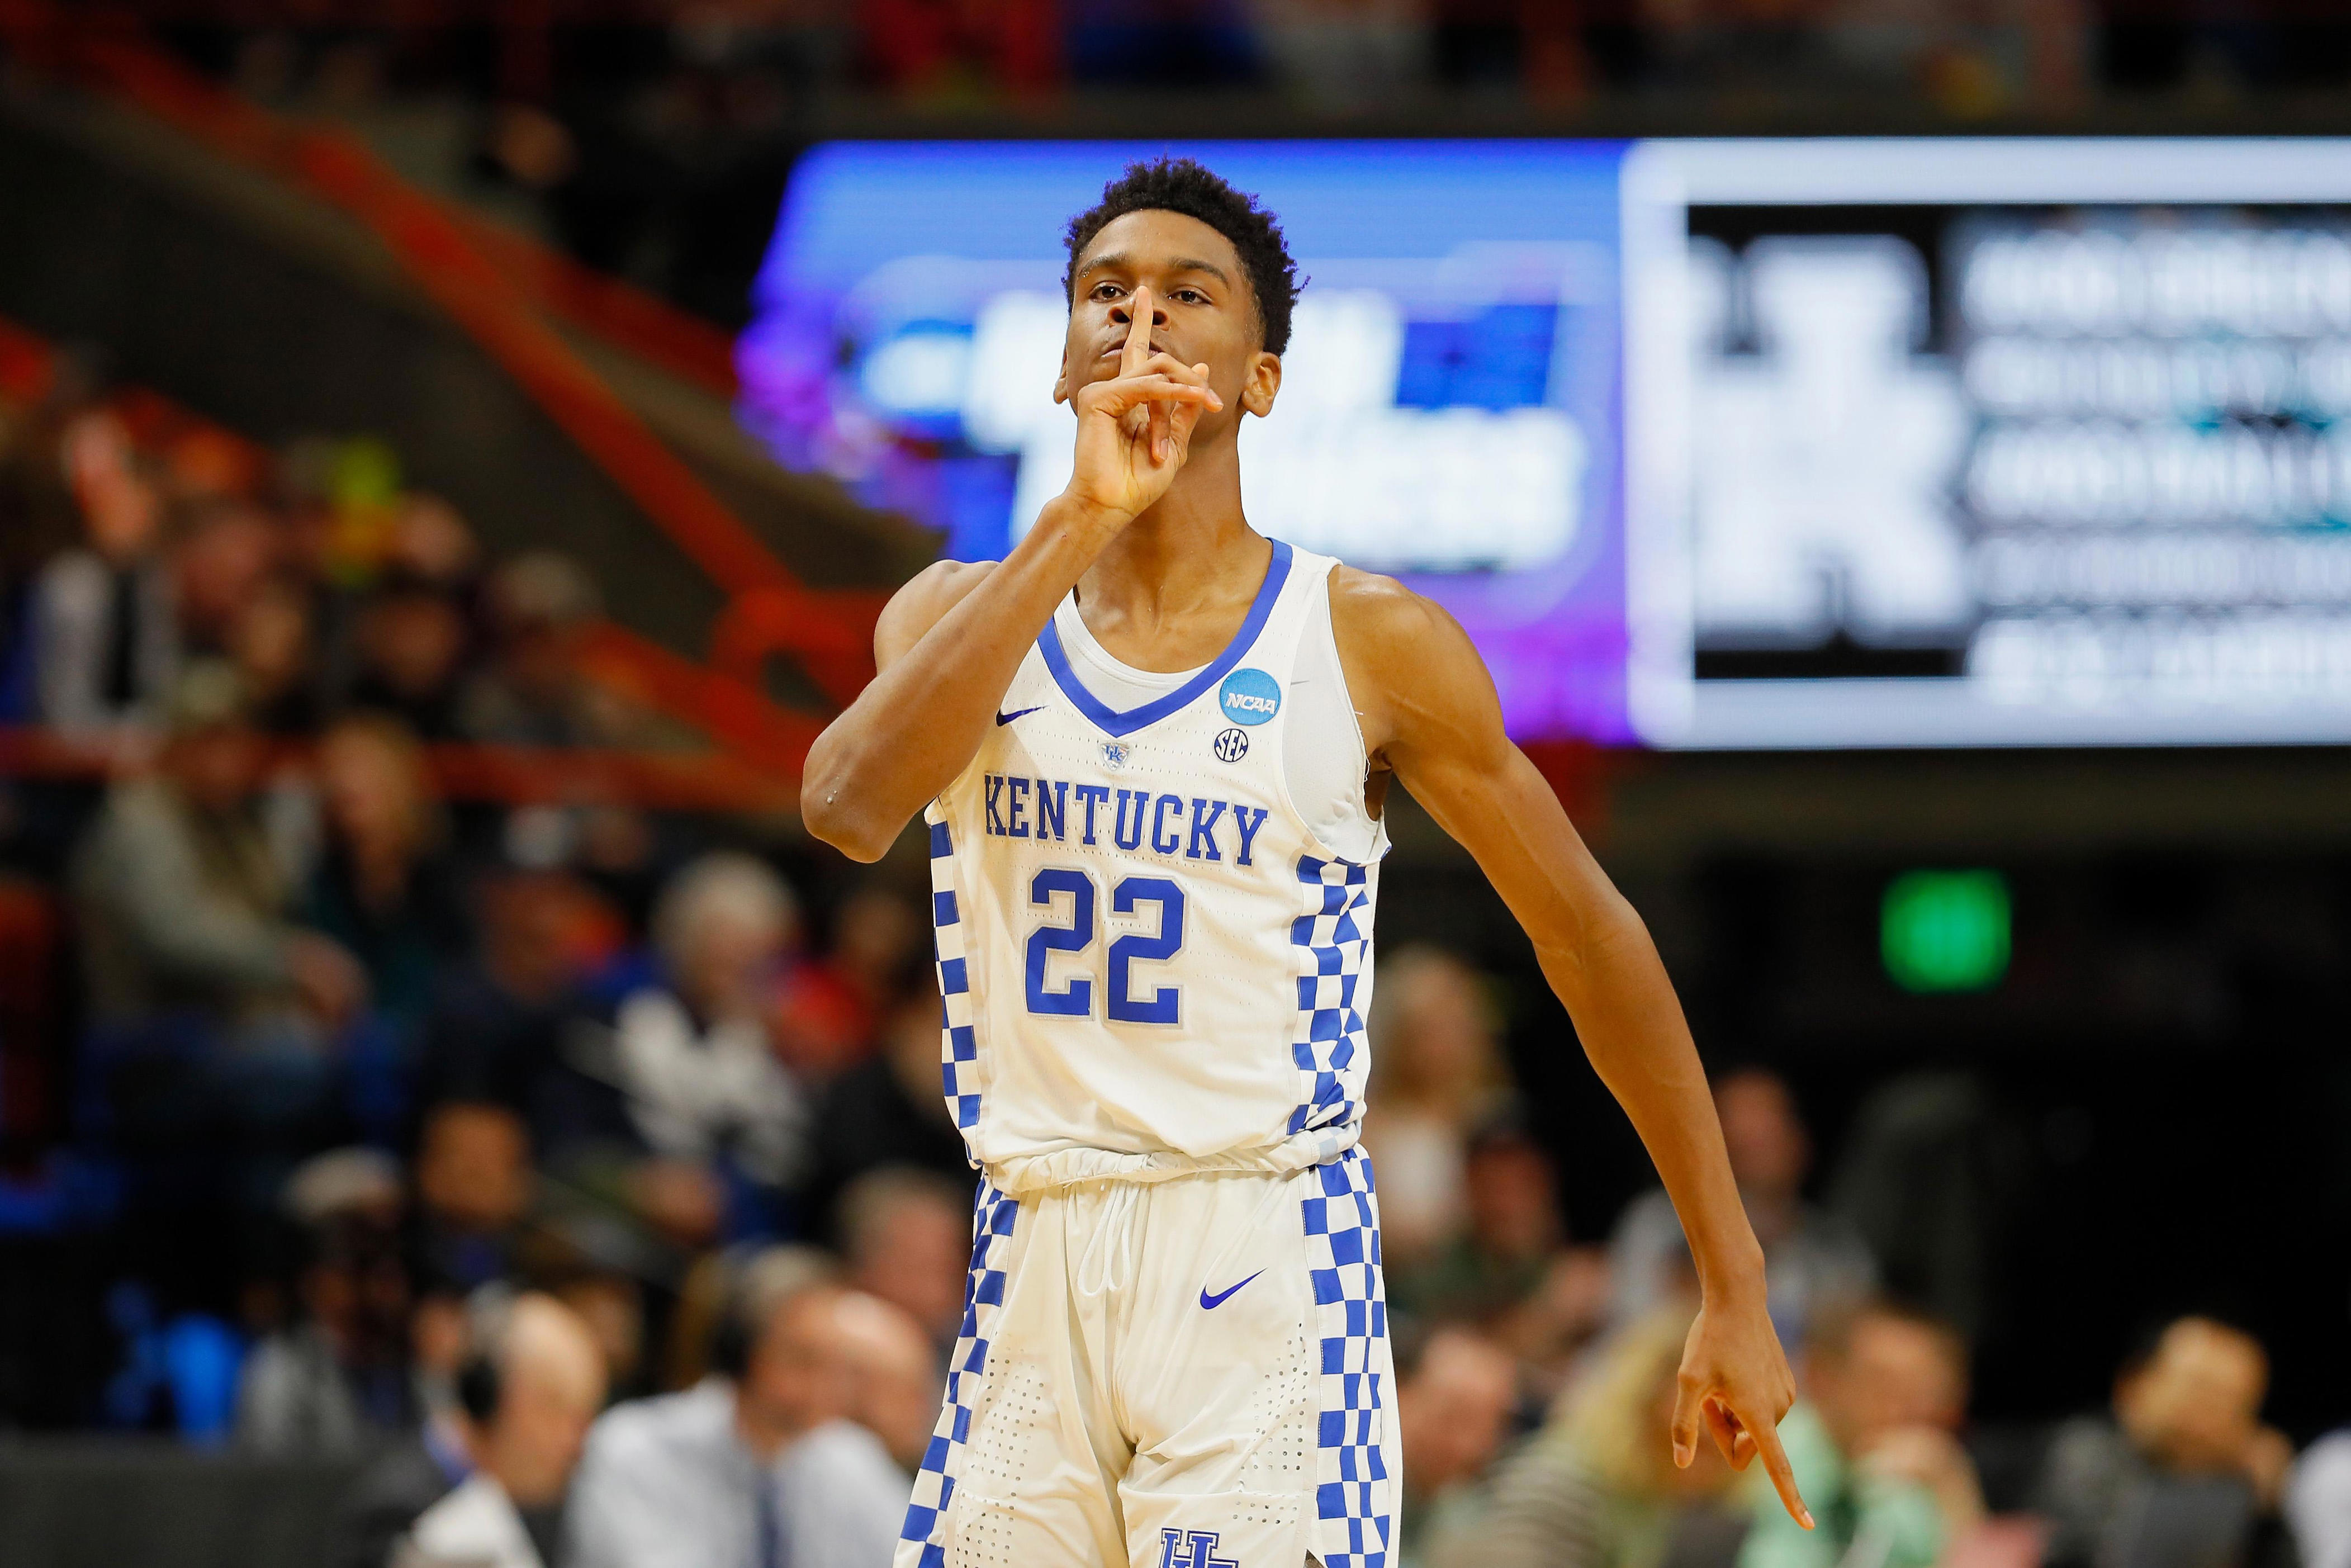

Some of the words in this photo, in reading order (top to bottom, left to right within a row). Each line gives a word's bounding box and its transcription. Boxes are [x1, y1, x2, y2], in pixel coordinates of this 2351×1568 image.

[1225, 692, 1277, 714] NCAA
[1105, 744, 1124, 762] UK
[1214, 729, 1248, 762] SEC
[984, 774, 1268, 867] KENTUCKY
[1023, 866, 1187, 1026] 22
[1159, 1527, 1239, 1568] U
